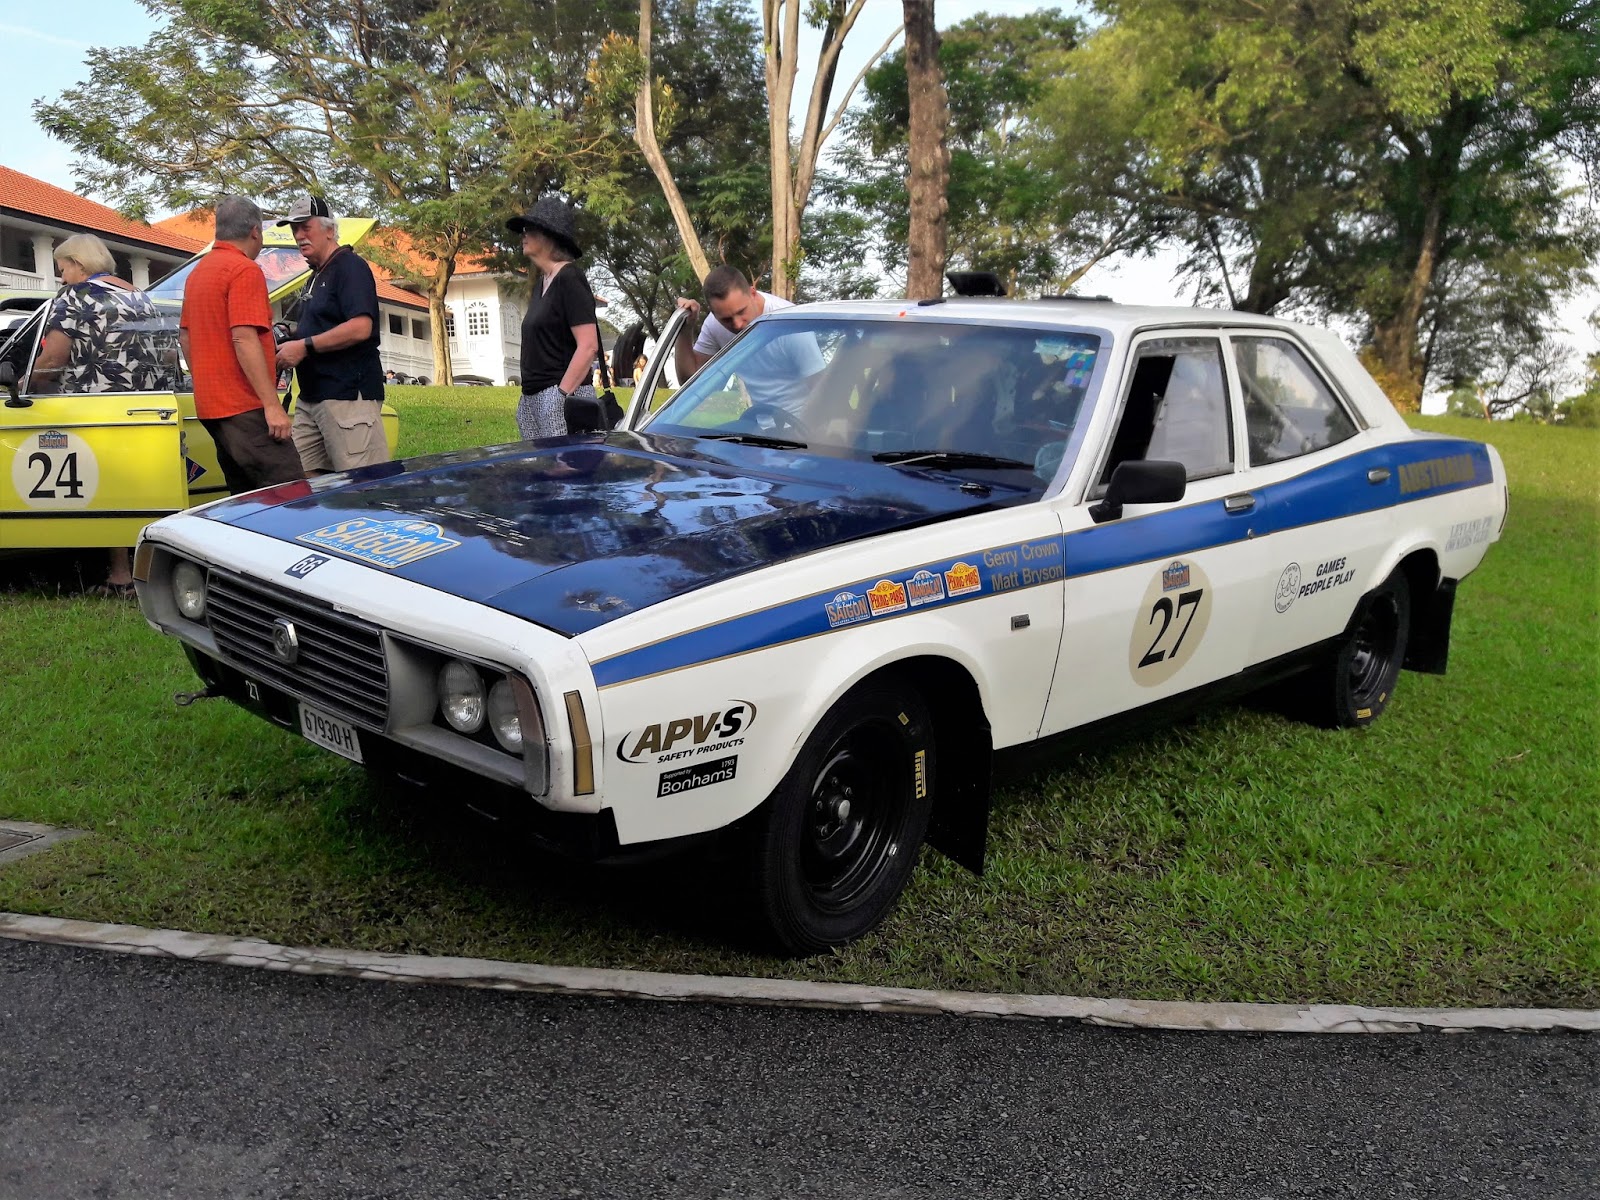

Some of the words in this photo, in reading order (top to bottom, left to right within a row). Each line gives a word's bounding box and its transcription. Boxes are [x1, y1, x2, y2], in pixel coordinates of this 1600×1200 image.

[28, 452, 84, 499] 24
[315, 520, 449, 561] SAIGON
[983, 549, 1018, 568] Gerry
[1021, 542, 1060, 560] Crown
[1316, 556, 1347, 577] GAMES
[991, 571, 1020, 592] Matt
[1022, 565, 1063, 585] Bryson
[1298, 576, 1334, 599] PEOPLE
[1333, 568, 1356, 587] PLAY
[827, 597, 868, 622] SAIGON
[1137, 588, 1204, 669] 27
[245, 680, 260, 701] 27
[657, 748, 695, 764] SAFETY
[696, 737, 745, 755] PRODUCTS
[721, 759, 735, 768] 1793
[661, 767, 733, 796] Bonhams
[914, 749, 927, 800] PIRELLI
